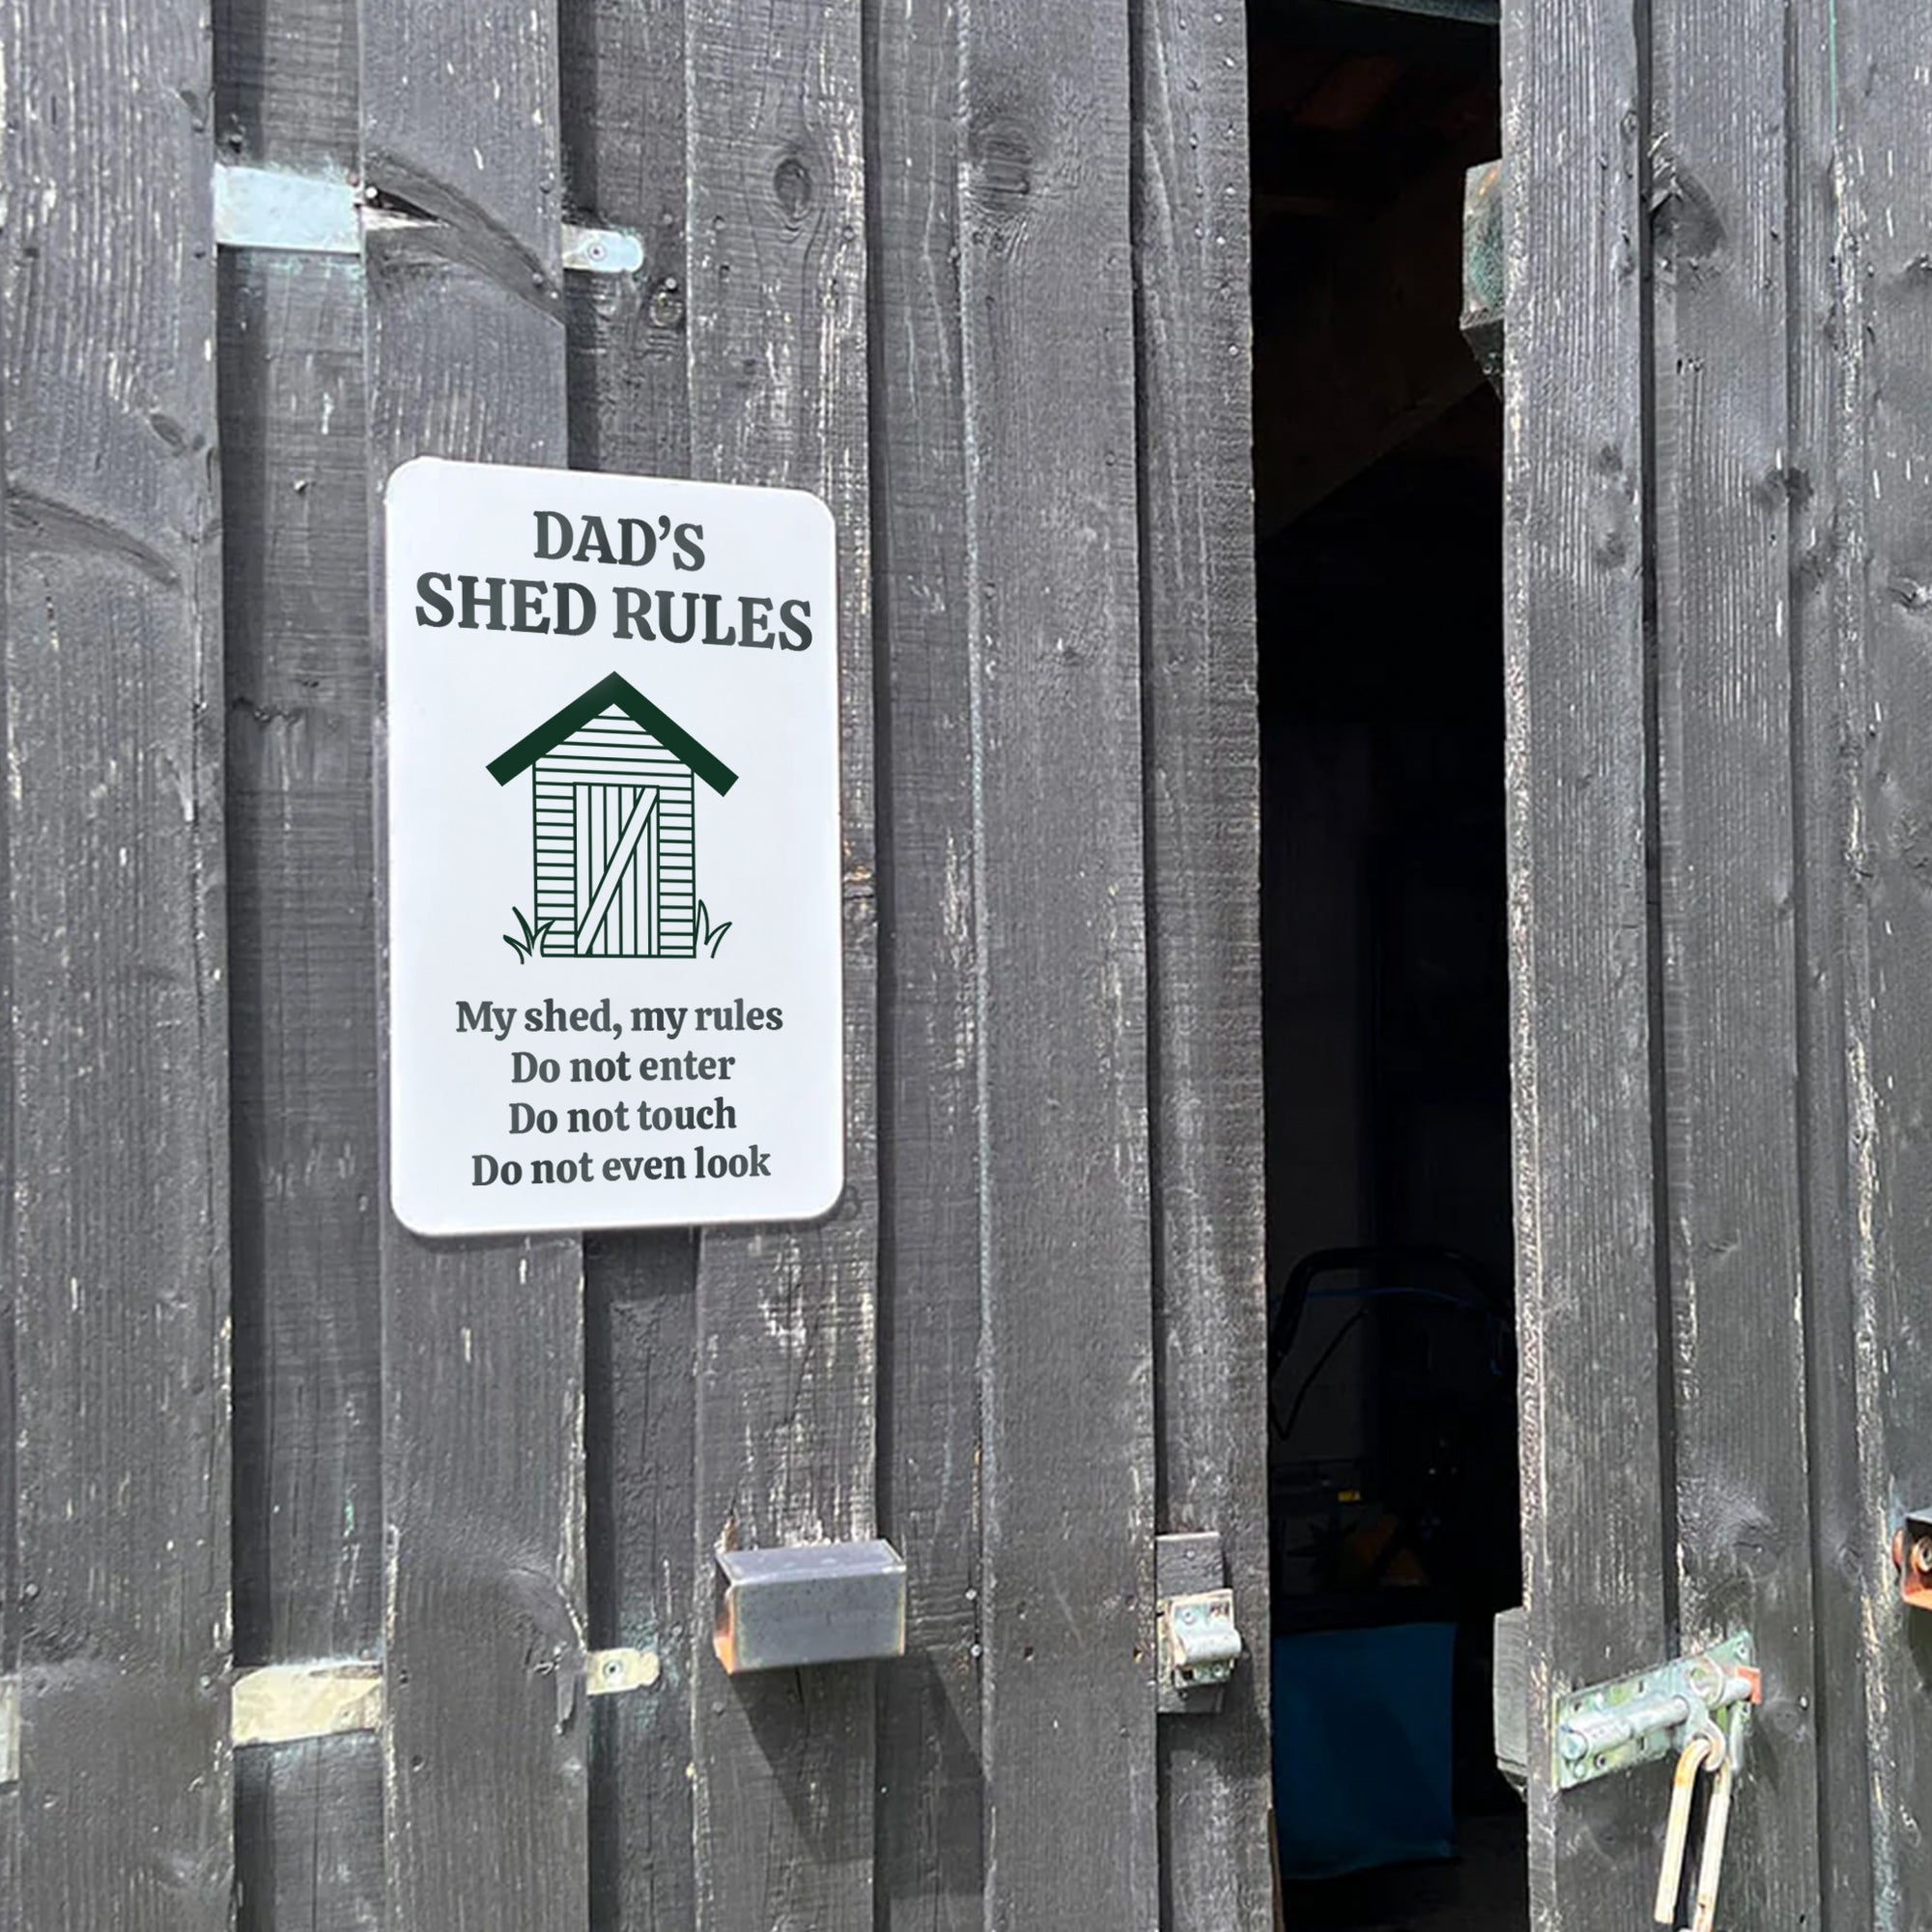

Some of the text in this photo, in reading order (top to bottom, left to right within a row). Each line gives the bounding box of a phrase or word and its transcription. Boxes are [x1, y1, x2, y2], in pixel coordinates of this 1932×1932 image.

[532, 510, 705, 572] DAD'S
[415, 571, 813, 652] SHED RULES
[455, 998, 783, 1041] My shed, my rules
[511, 1050, 736, 1084] Do not enter
[508, 1095, 737, 1134] Do not touch
[471, 1144, 772, 1186] Do not even look
